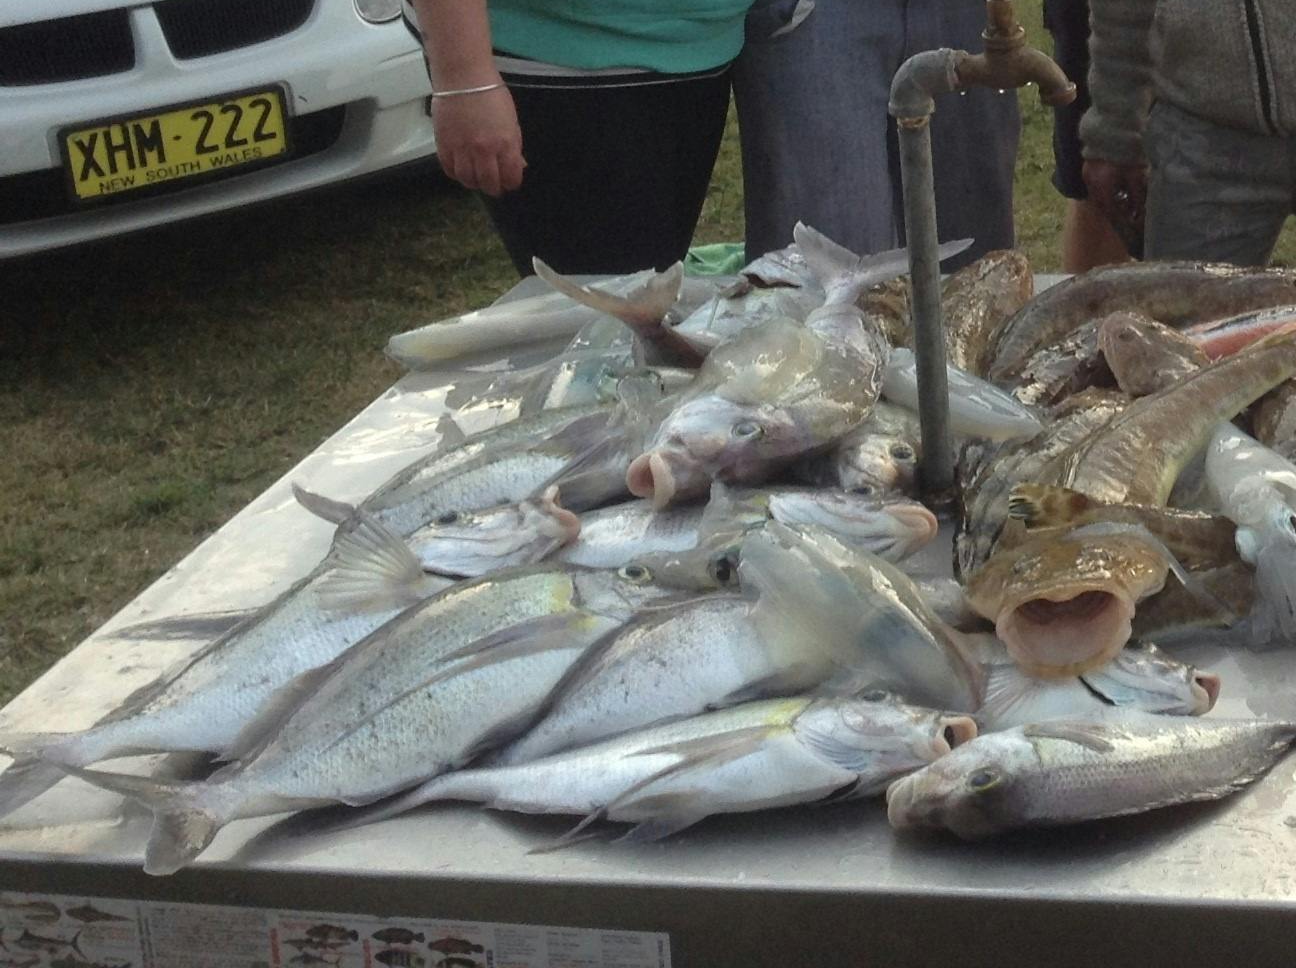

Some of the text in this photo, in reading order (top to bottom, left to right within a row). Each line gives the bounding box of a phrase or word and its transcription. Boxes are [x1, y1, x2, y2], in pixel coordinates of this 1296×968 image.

[99, 146, 263, 194] NEW SOUTH WALES
